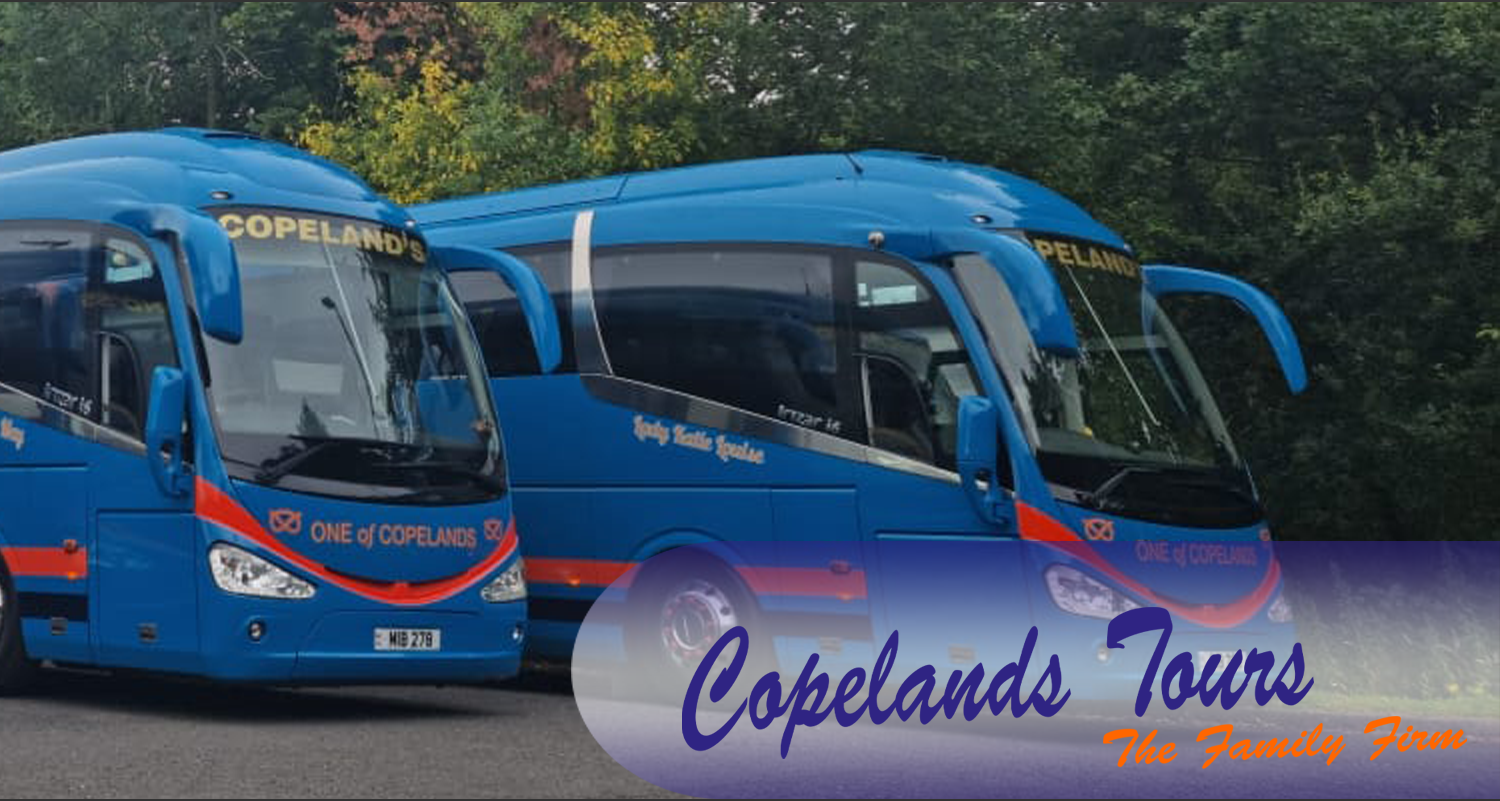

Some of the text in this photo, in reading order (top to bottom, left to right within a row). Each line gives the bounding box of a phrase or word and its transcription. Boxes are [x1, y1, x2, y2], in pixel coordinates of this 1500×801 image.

[218, 213, 428, 264] COPELAND'S
[311, 521, 477, 549] ONE of COPELANDS
[1135, 540, 1170, 563] ONE
[389, 631, 433, 648] MIB 278
